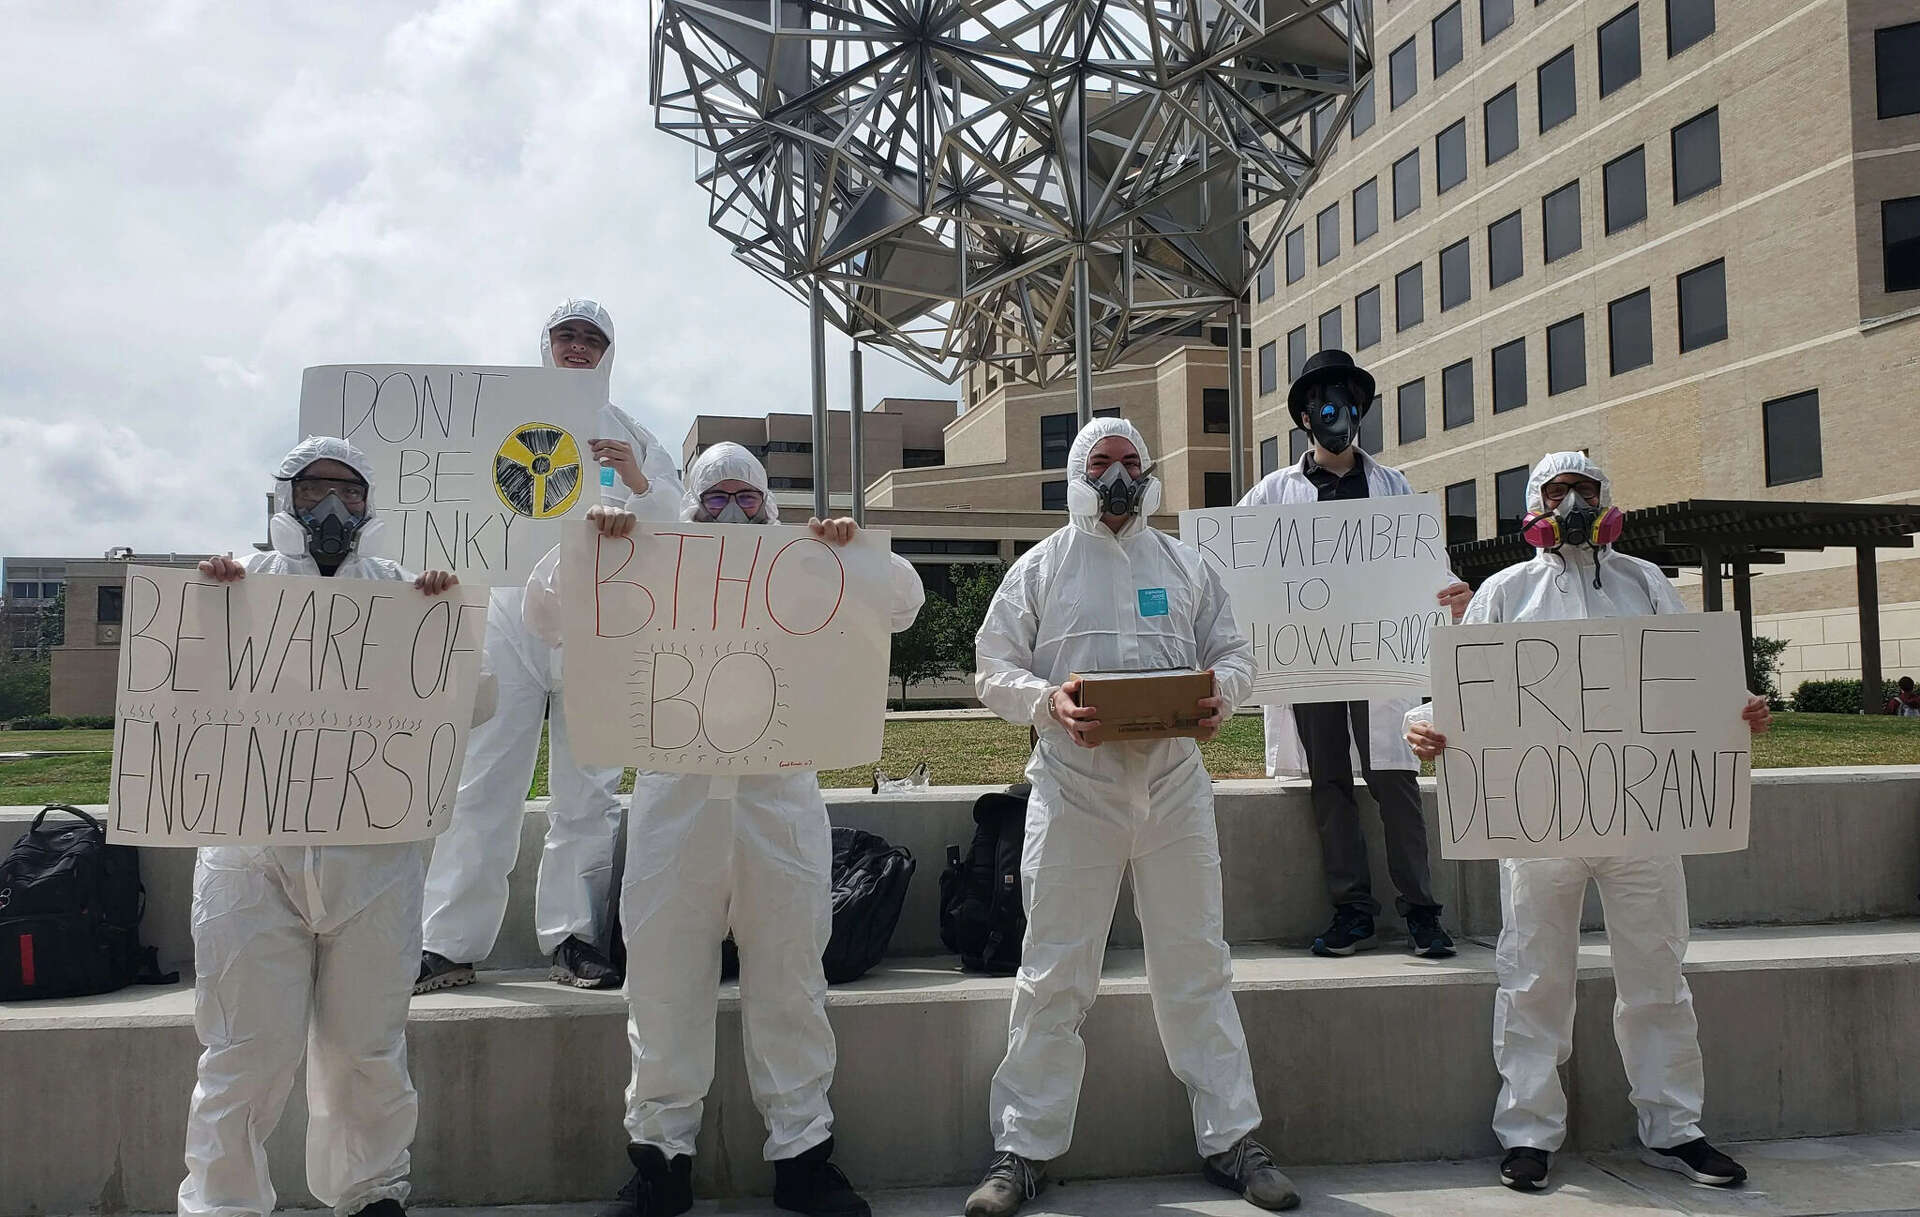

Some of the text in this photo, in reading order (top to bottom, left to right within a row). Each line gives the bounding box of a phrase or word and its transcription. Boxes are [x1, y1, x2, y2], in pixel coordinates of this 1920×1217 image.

[341, 371, 509, 443] DON'T
[399, 450, 475, 504] BE
[376, 509, 516, 571] INKY
[1196, 513, 1440, 569] REMEMBER
[1283, 577, 1330, 613] TO
[127, 576, 487, 699] BEWARE OF
[1251, 611, 1446, 670] HOWER!!!
[1456, 629, 1699, 734] FREE
[116, 719, 457, 836] ENGINEERS!
[1443, 742, 1747, 843] DEODORANT
